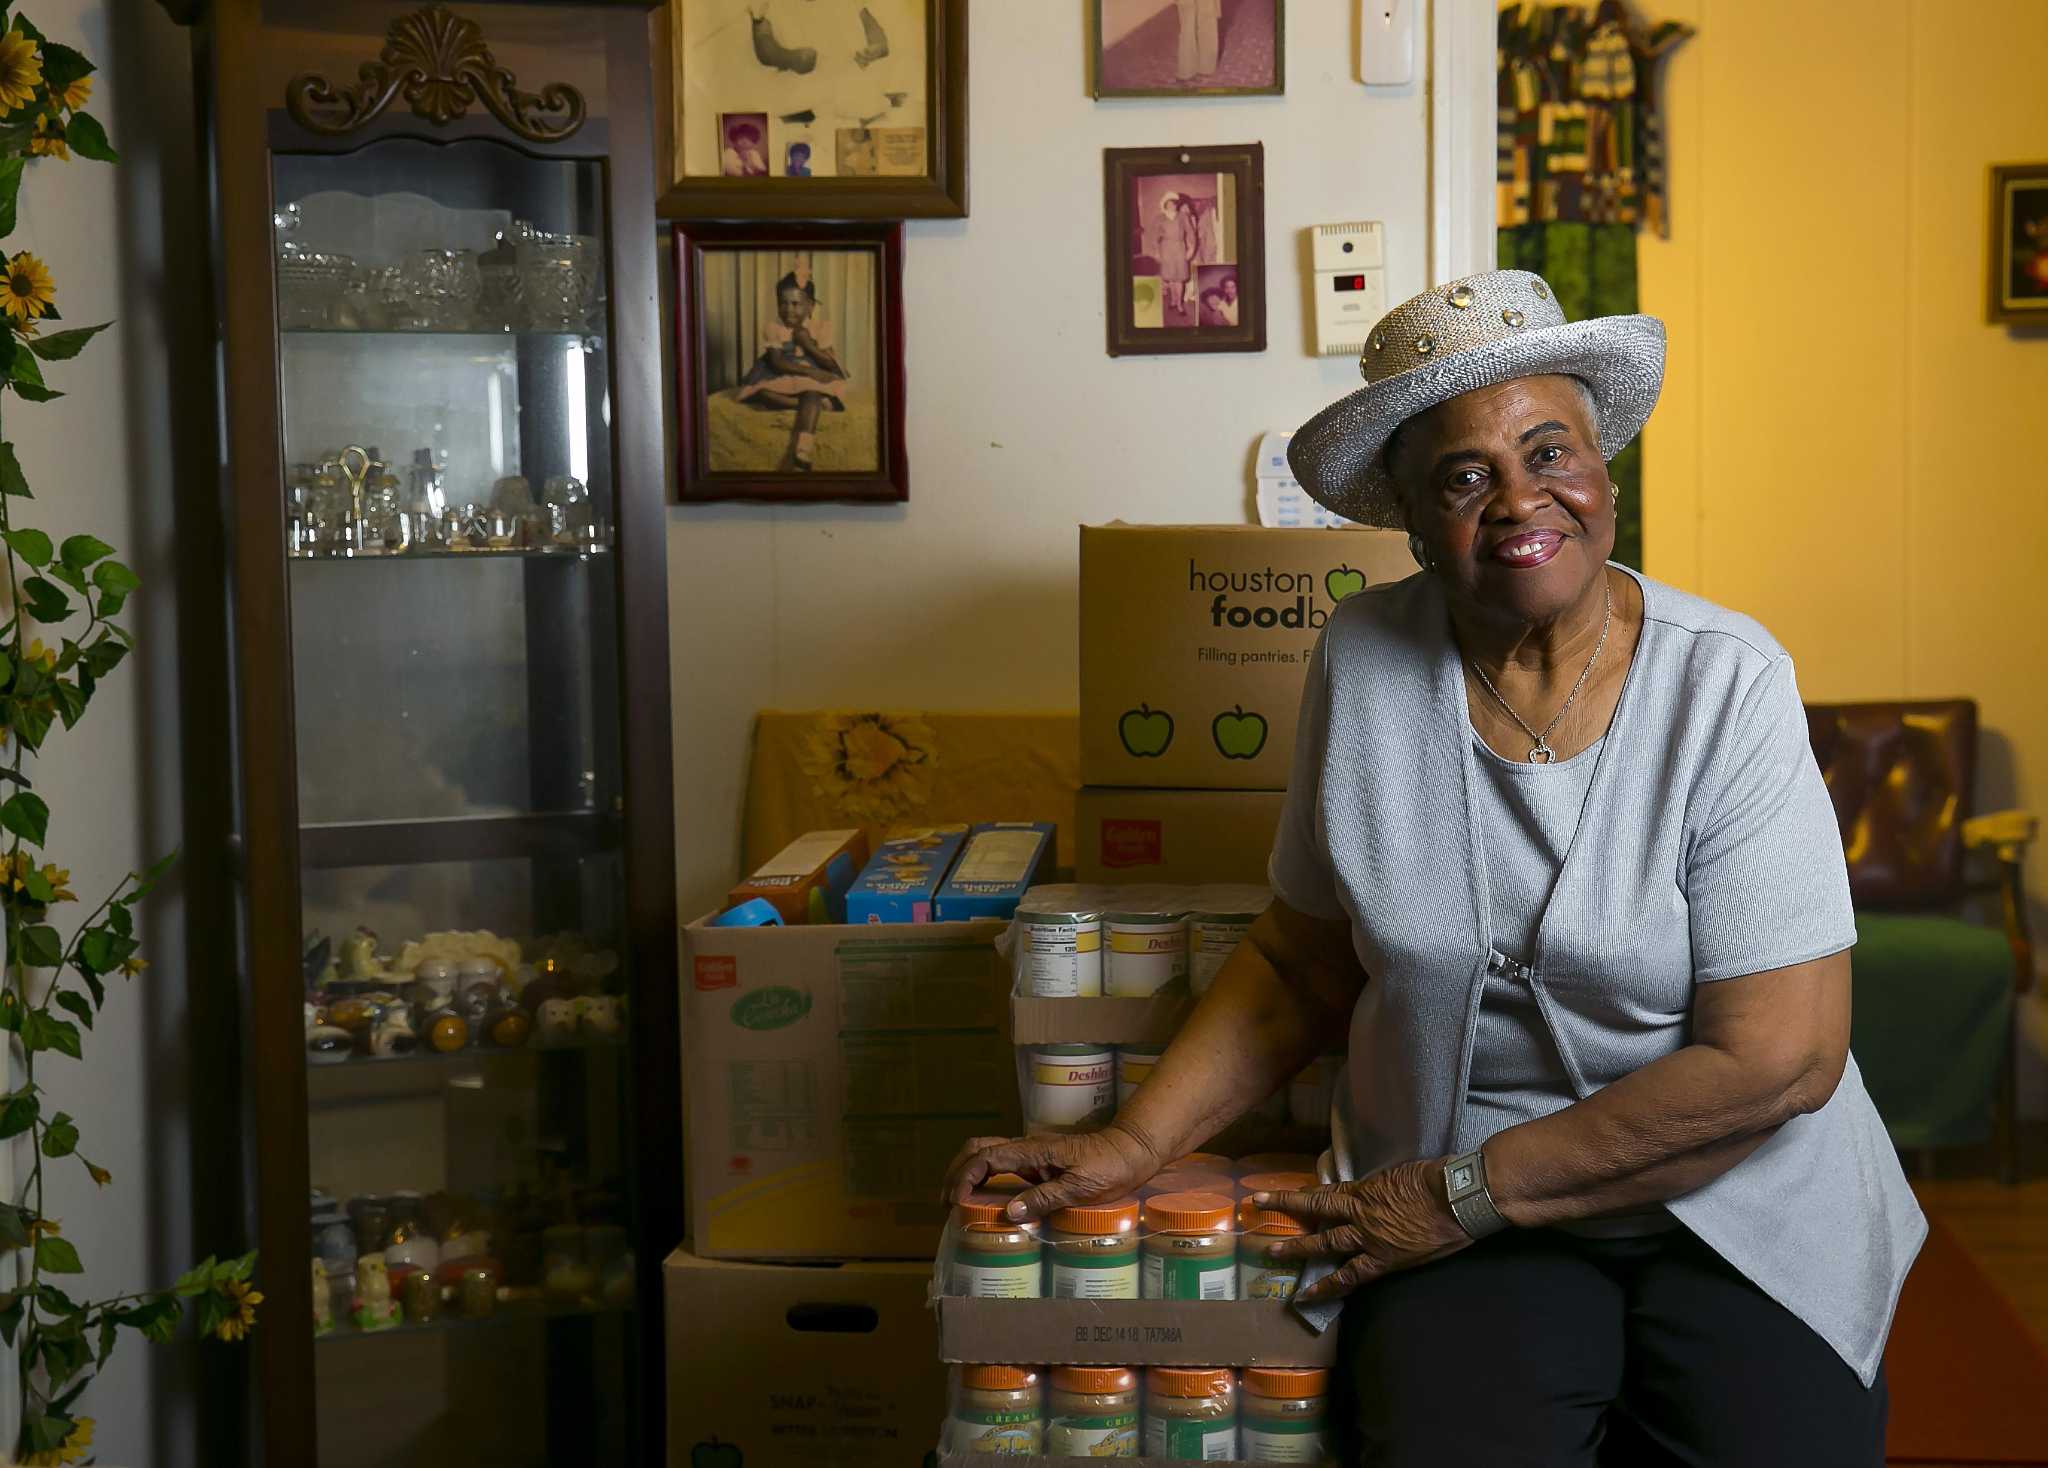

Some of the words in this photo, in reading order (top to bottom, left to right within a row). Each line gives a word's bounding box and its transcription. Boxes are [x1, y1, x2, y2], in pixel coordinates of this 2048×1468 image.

[1188, 559, 1313, 593] houston
[1210, 594, 1328, 629] foodb
[1198, 648, 1237, 665] Filling
[1240, 649, 1299, 666] pantries.
[1093, 1325, 1113, 1342] DEC
[985, 1412, 1036, 1424] CREAM
